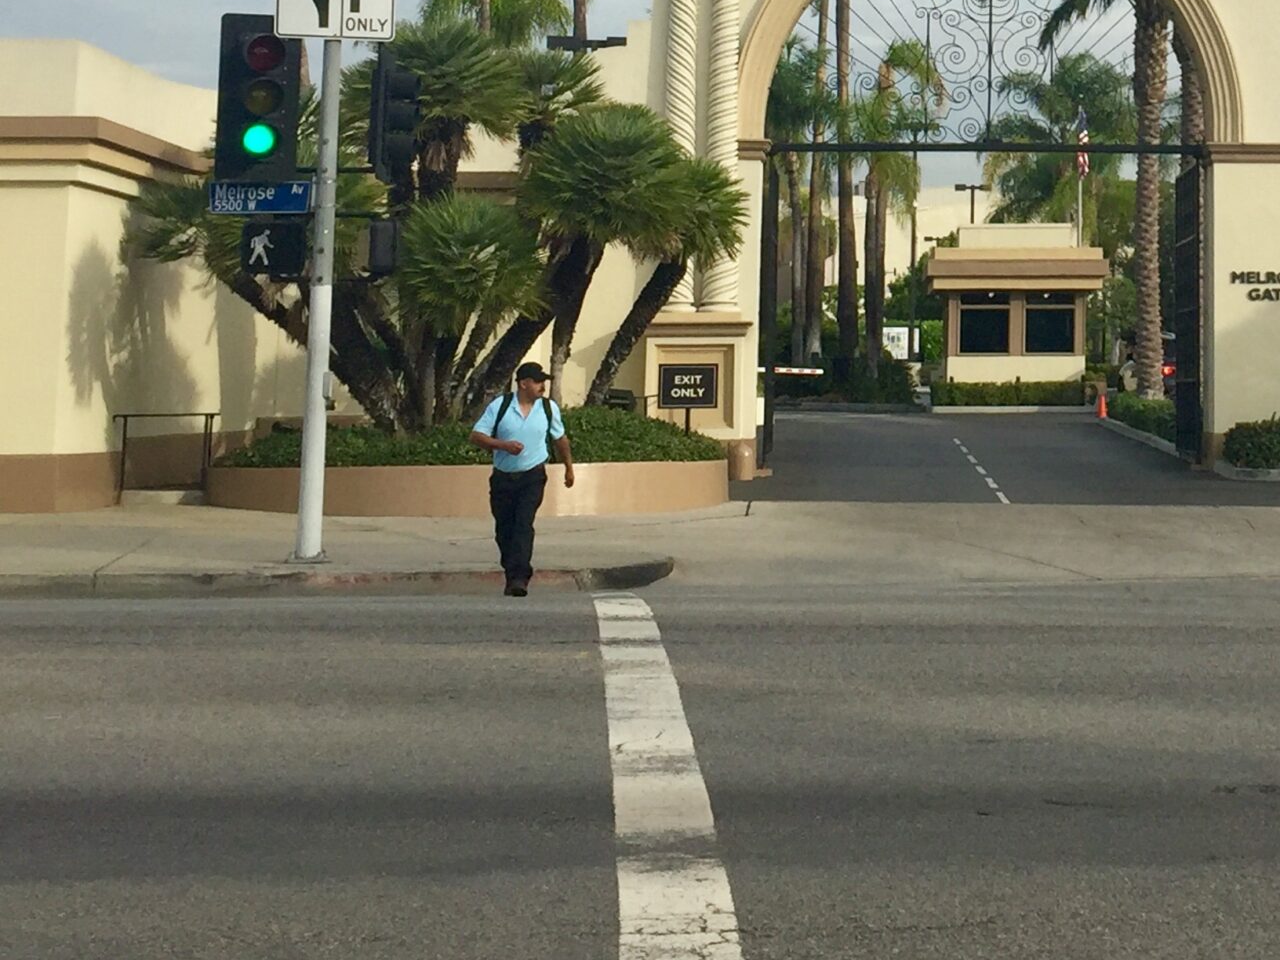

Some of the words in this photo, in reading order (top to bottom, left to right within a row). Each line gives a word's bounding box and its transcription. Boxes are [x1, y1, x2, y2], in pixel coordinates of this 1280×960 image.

[345, 17, 388, 32] ONLY
[215, 184, 275, 200] Melrose
[291, 184, 304, 194] Av
[214, 200, 243, 211] 5500
[247, 200, 257, 211] W
[674, 375, 703, 385] EXIT
[670, 388, 705, 398] ONLY
